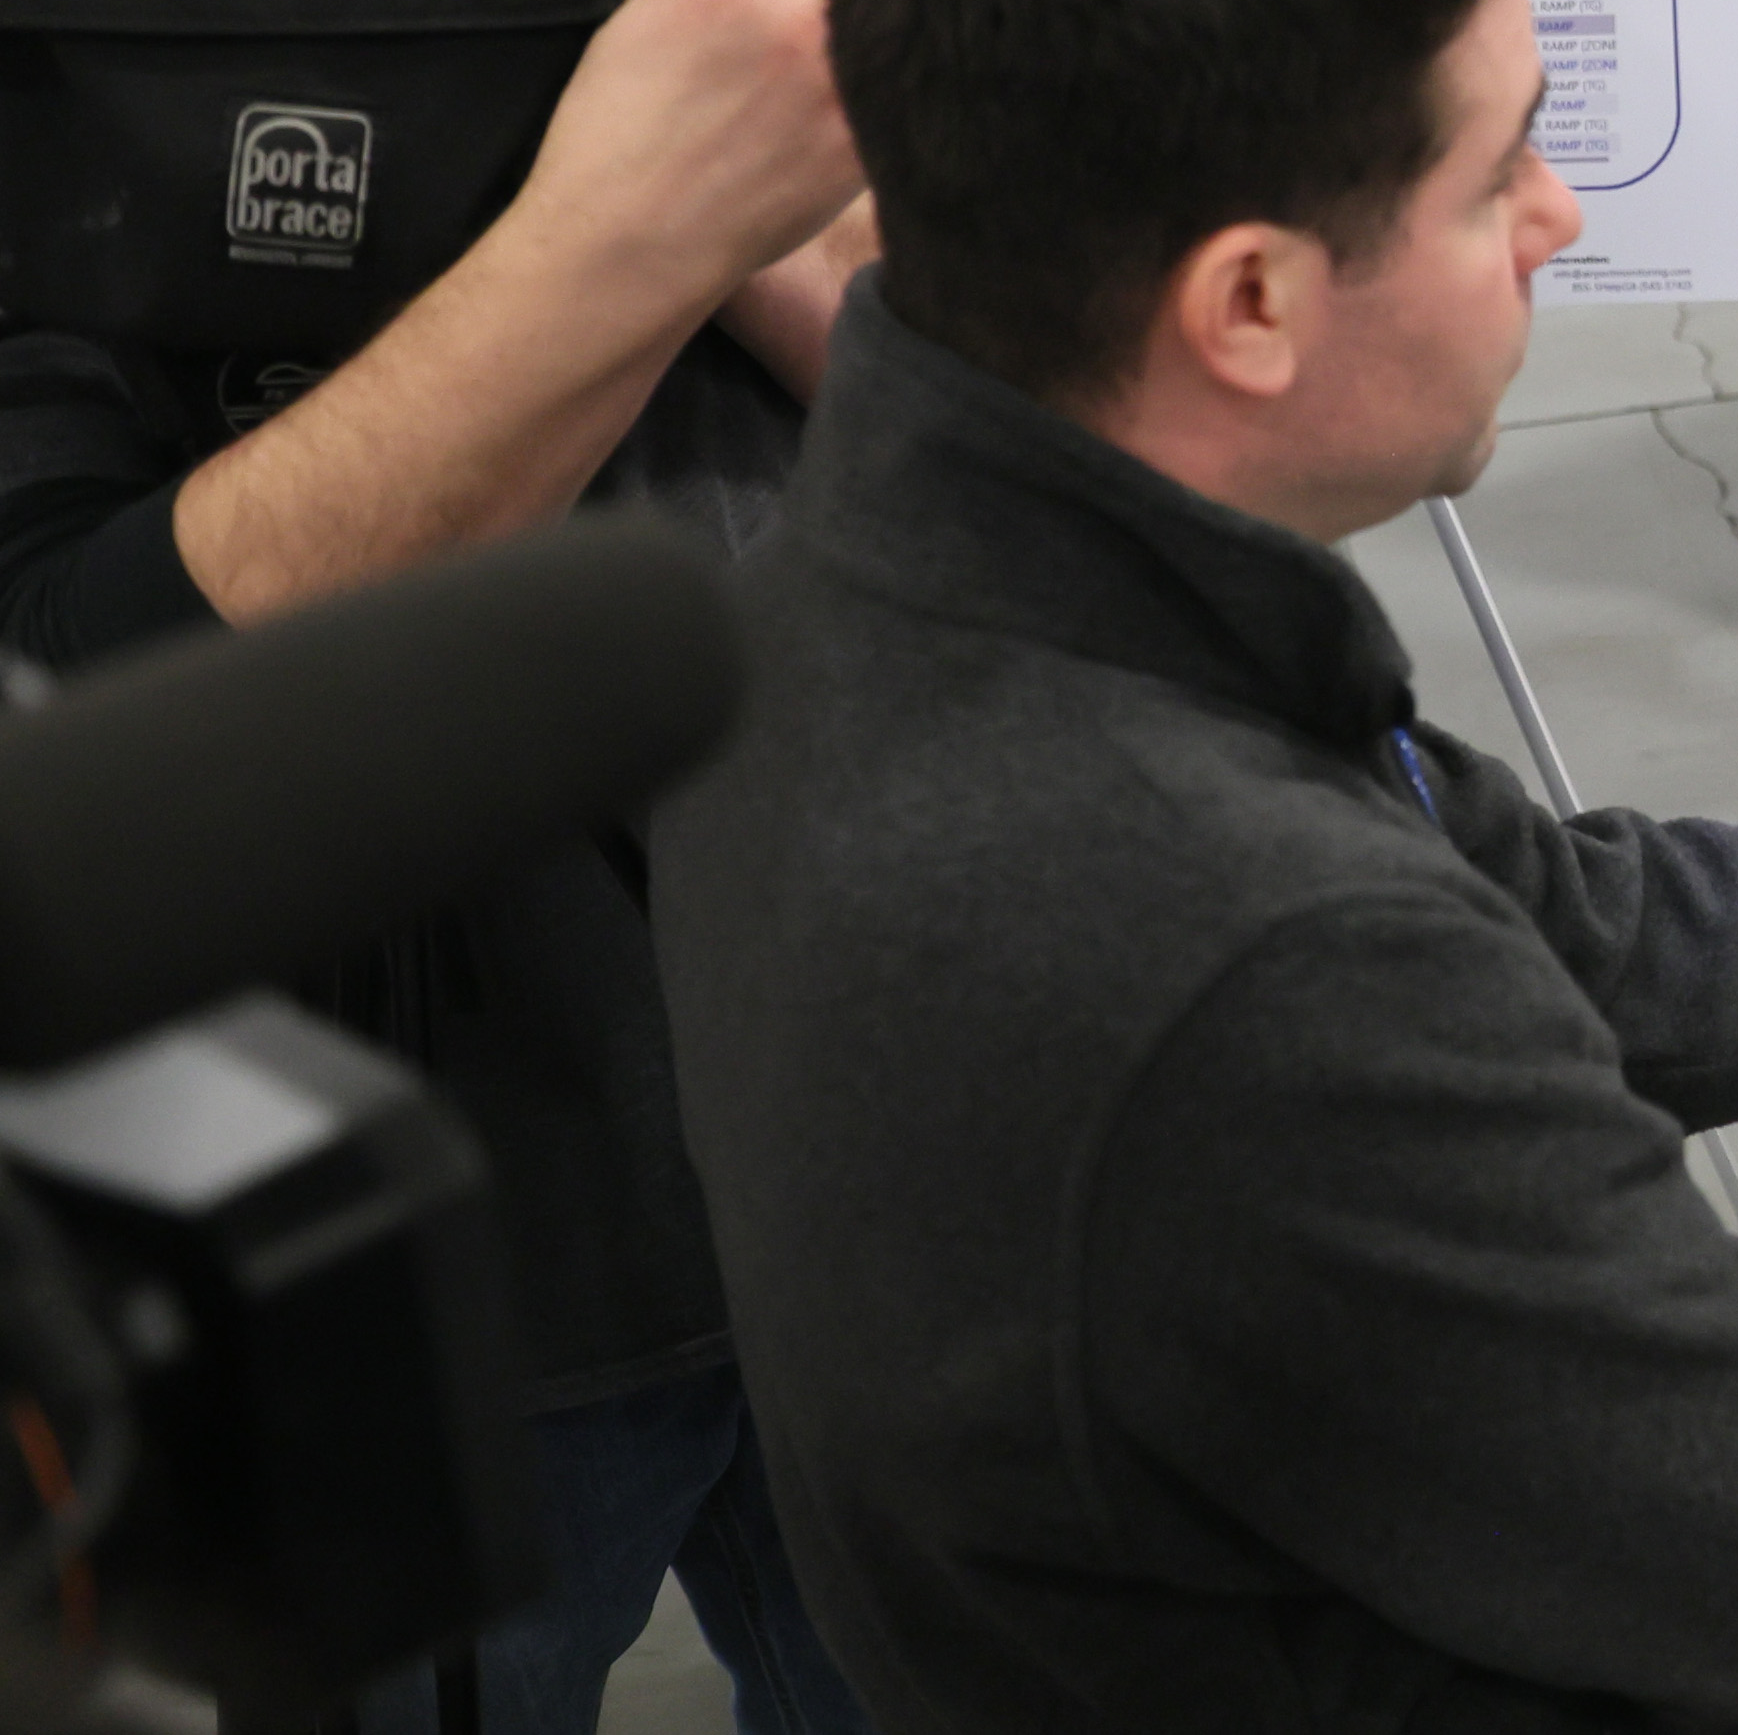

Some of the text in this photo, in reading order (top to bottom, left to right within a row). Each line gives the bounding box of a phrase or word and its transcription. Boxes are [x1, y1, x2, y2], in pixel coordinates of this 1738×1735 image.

[1540, 1, 1576, 11] RAMP
[1538, 21, 1573, 32] RAMP
[1542, 40, 1577, 51] RAMP
[1551, 100, 1586, 111] RAMP
[1546, 120, 1581, 131] RAMP
[1547, 140, 1581, 151] RAMP
[241, 145, 357, 194] porta
[236, 195, 351, 240] brace
